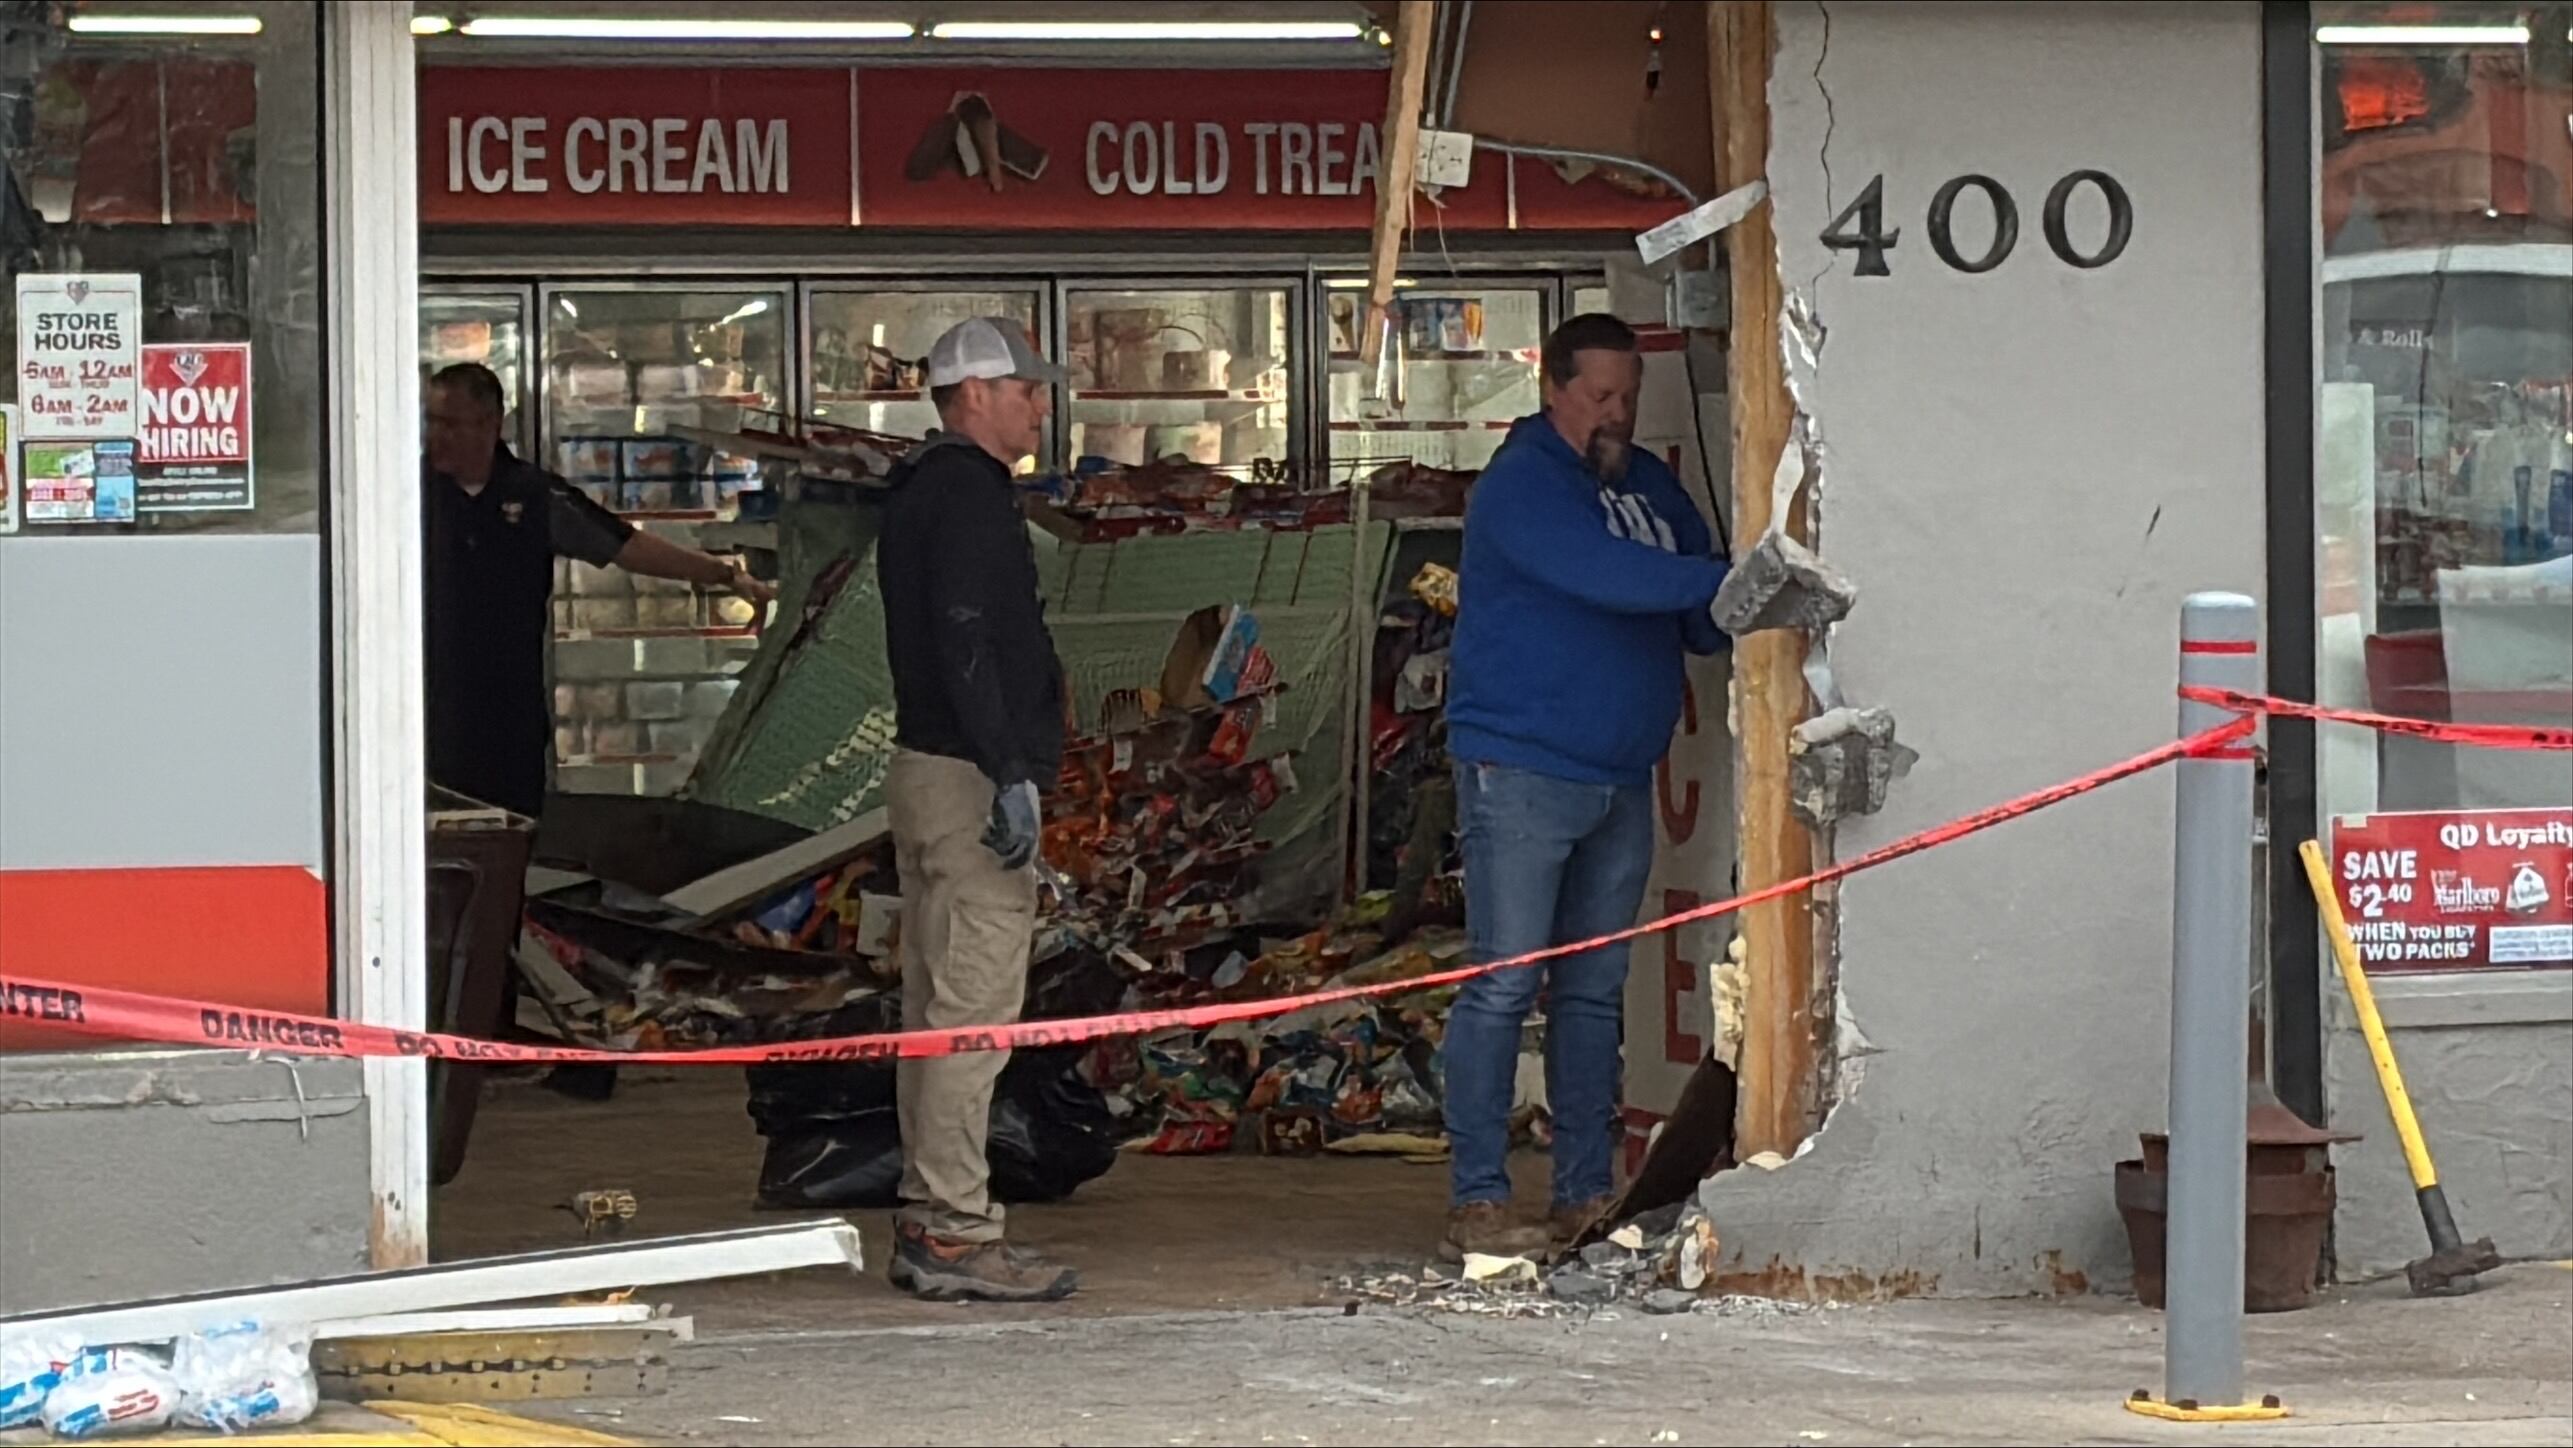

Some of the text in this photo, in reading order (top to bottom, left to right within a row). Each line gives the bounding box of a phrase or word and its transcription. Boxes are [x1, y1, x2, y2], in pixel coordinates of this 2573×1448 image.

[448, 116, 789, 194] ICE CREAM
[1085, 120, 1230, 196] COLD
[1819, 169, 2134, 277] 400
[37, 313, 118, 331] STORE
[34, 333, 121, 351] HOURS
[79, 360, 133, 379] 12AM
[31, 394, 128, 414] 6AM 2AM
[142, 386, 239, 425] NOW
[141, 427, 239, 458] HIRING
[2440, 823, 2479, 850] QD
[2343, 850, 2418, 880] SAVE
[2346, 921, 2476, 941] WHEN YOU BUY
[2355, 943, 2402, 960] TWO
[201, 1008, 343, 1049] DANGER
